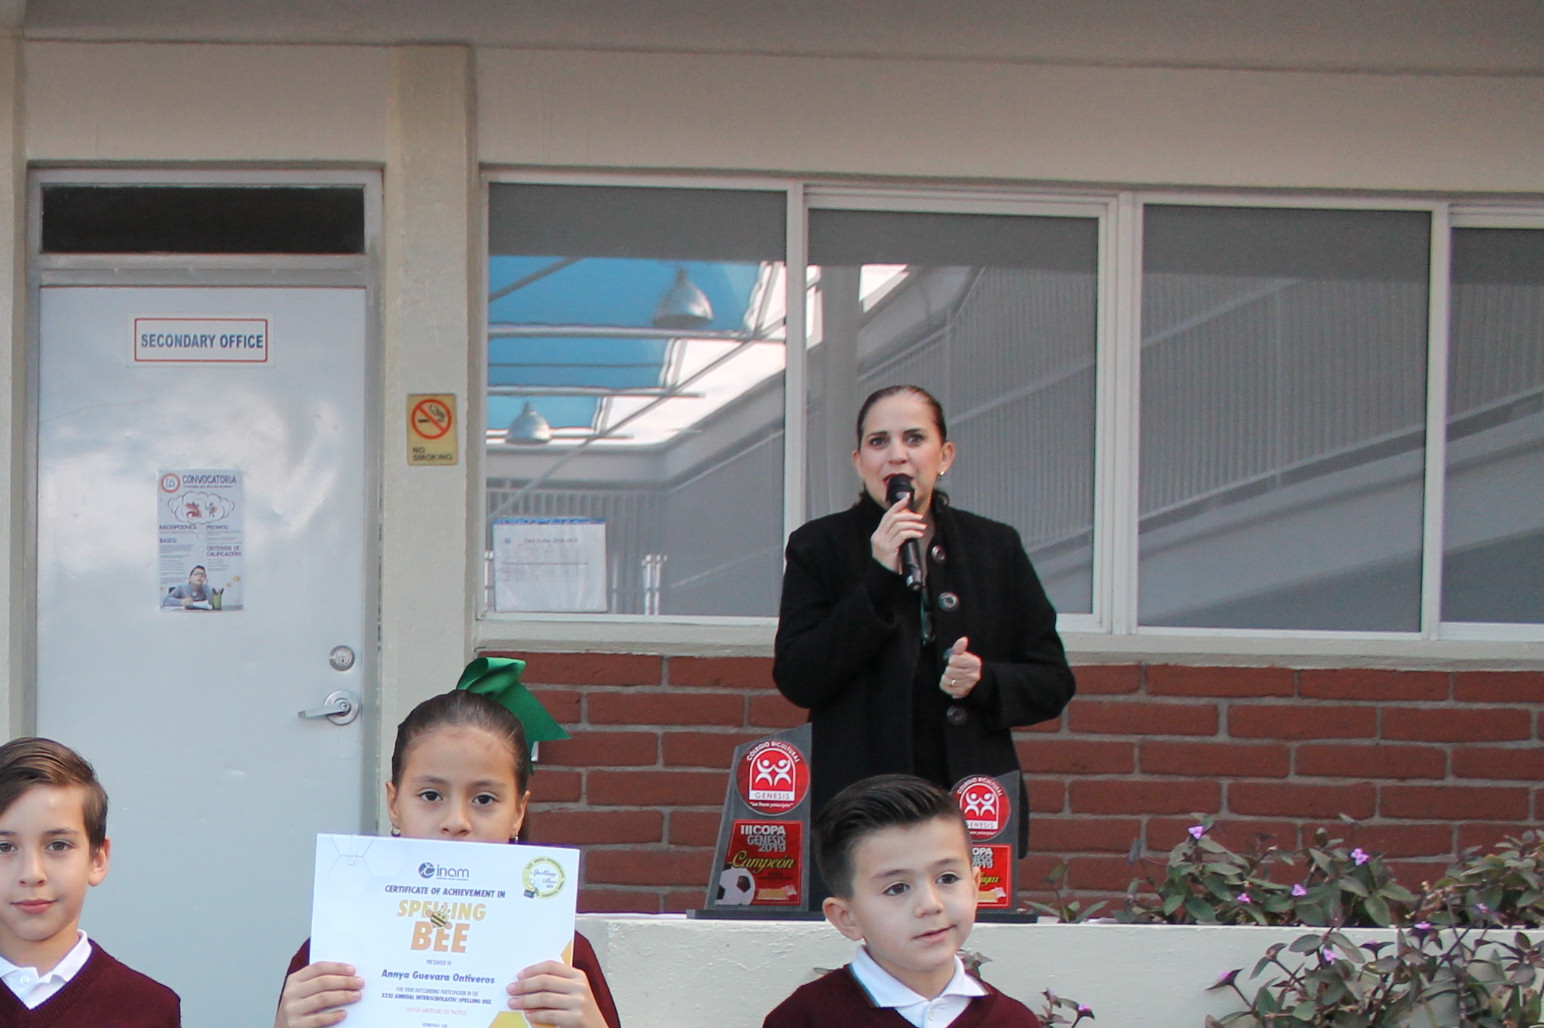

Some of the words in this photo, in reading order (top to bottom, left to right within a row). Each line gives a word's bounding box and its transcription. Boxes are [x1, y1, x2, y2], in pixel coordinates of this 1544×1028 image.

[141, 334, 215, 348] SECONDARY
[220, 334, 263, 348] OFFICE
[413, 453, 452, 461] SMOKING
[182, 475, 236, 484] CONVOCATORIA
[758, 844, 786, 852] 2019
[733, 850, 794, 873] Campeón
[437, 865, 469, 877] inam
[385, 885, 428, 894] CERTIFICATE
[443, 888, 495, 897] ACHIEVEMENT
[411, 921, 470, 953] BEE
[381, 969, 409, 980] Annya
[453, 973, 495, 984] Ontiveros
